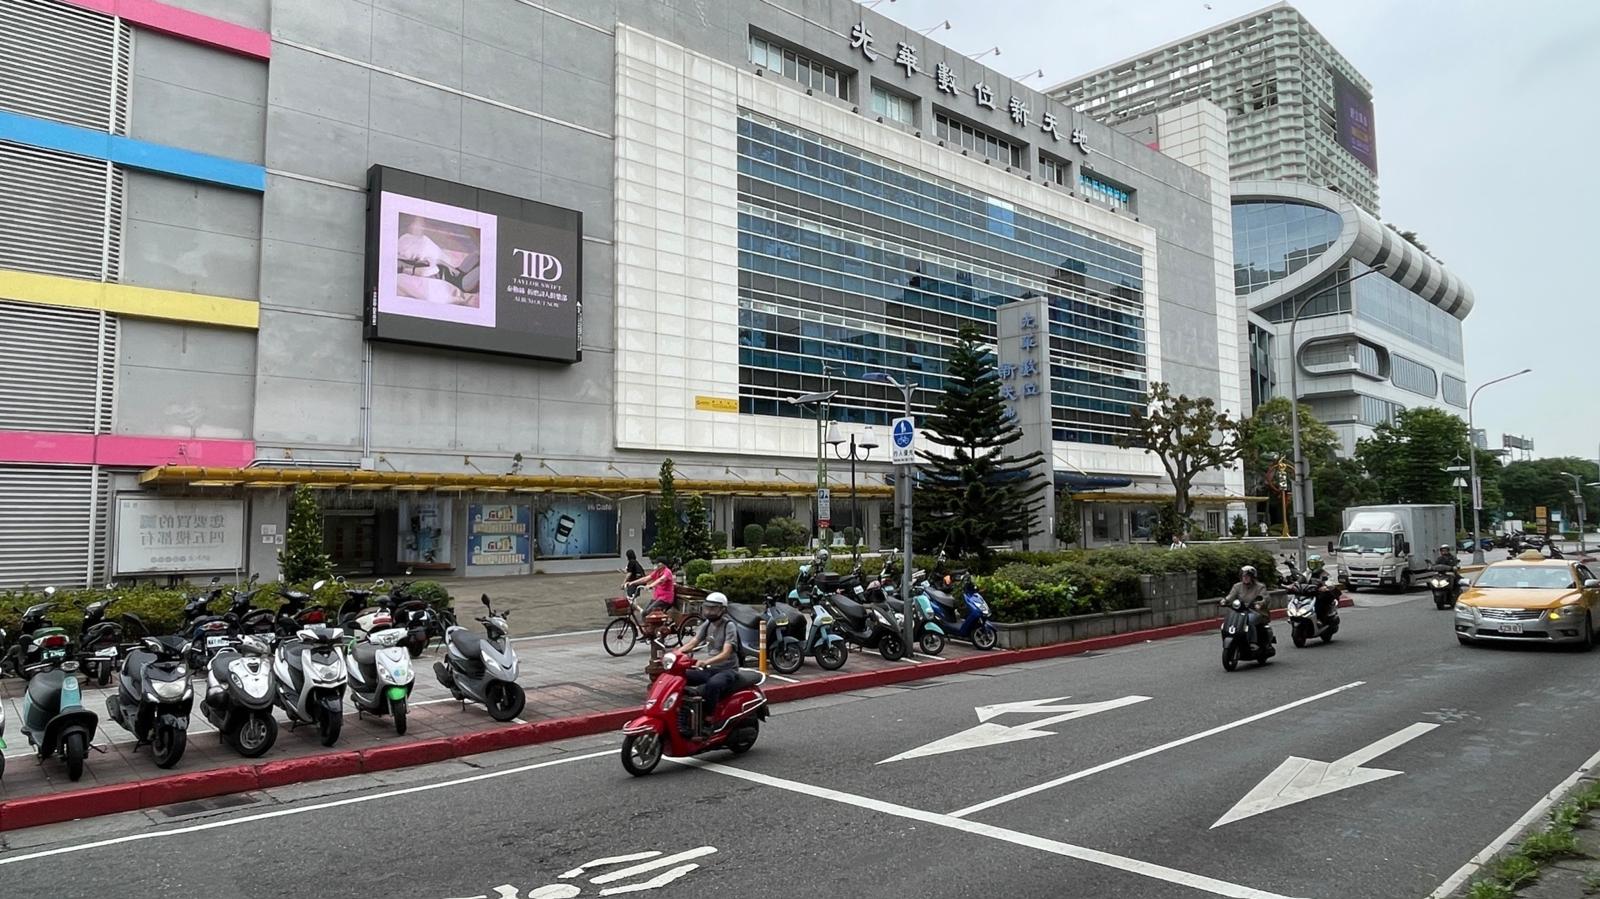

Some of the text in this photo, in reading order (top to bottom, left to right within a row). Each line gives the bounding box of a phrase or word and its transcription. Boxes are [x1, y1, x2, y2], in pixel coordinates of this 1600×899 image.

[851, 21, 1091, 154] 光華數位新天地
